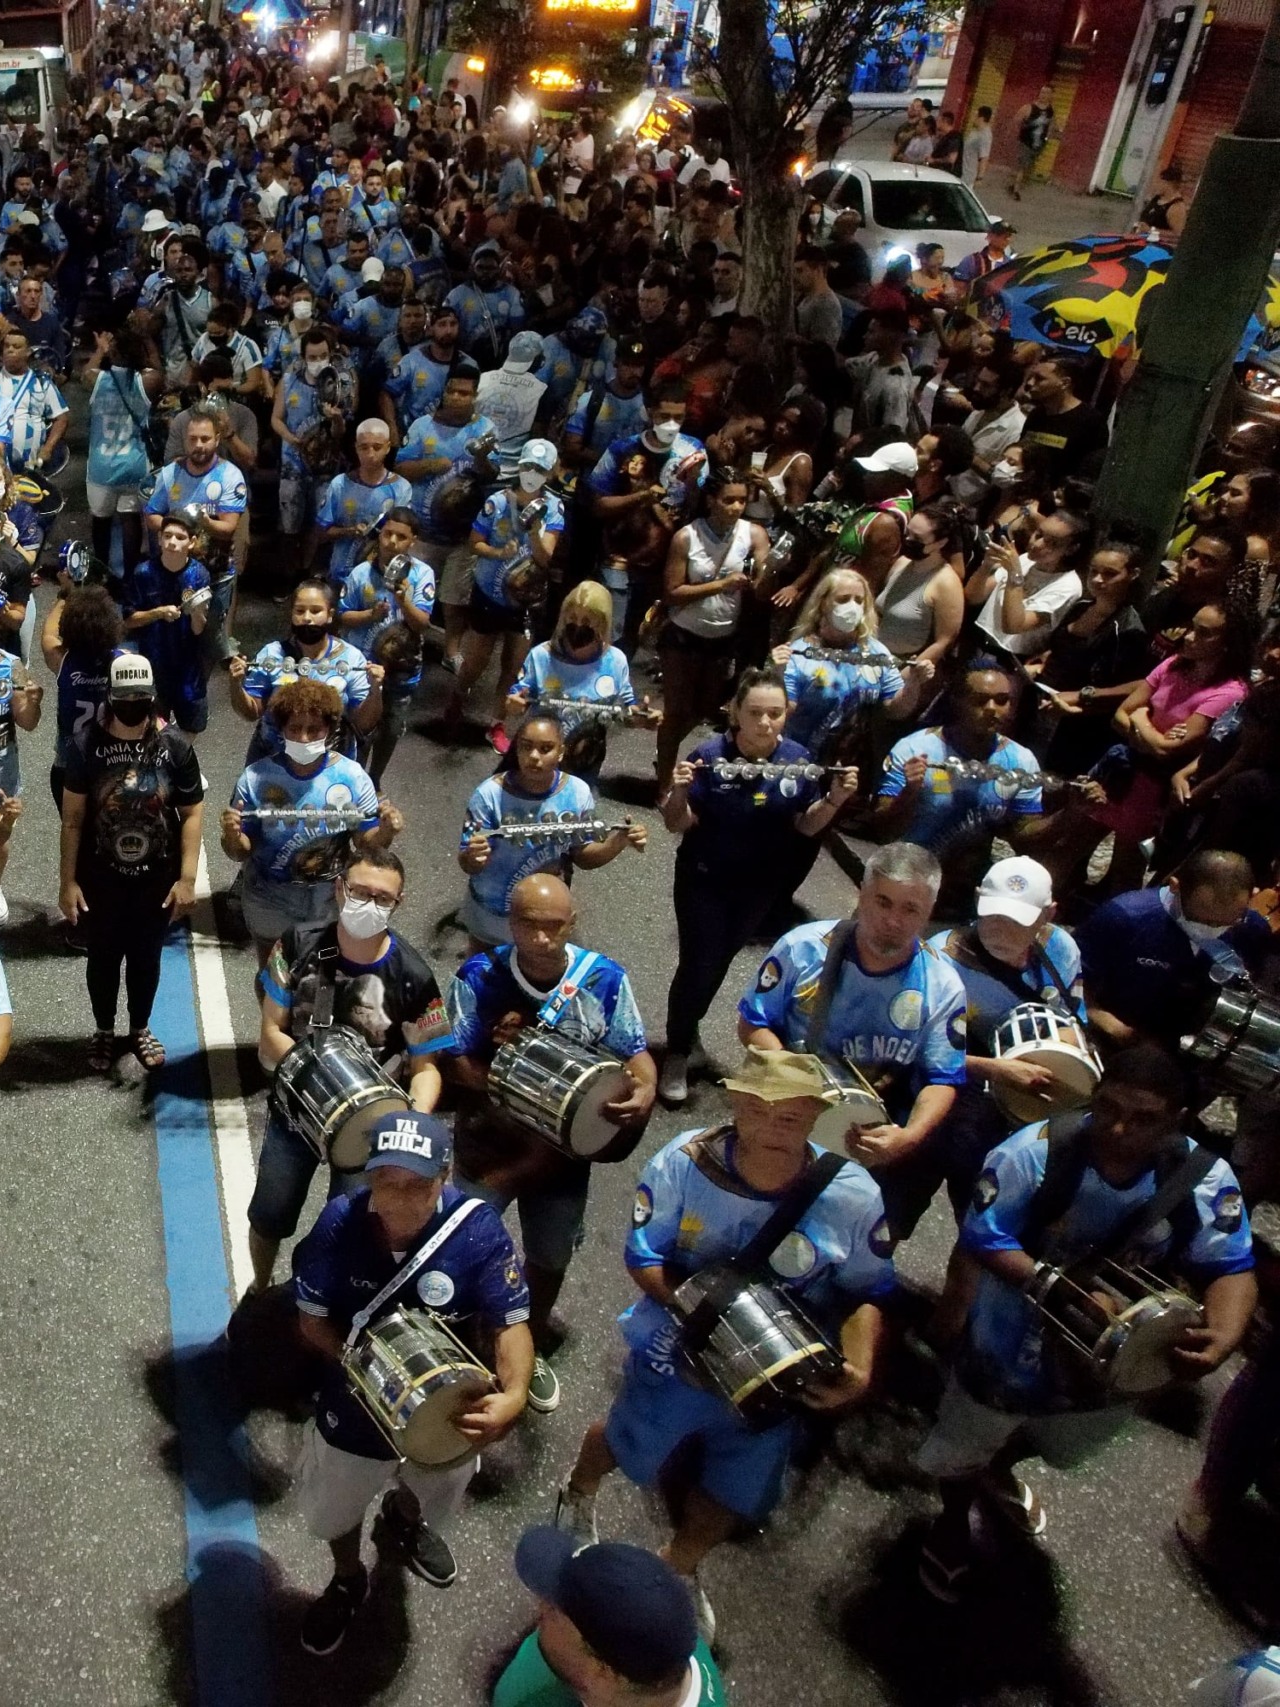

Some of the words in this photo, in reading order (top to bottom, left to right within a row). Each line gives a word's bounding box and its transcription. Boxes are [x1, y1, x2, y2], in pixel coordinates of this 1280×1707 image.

[1065, 325, 1098, 344] elo
[115, 669, 149, 681] CHOCALHO
[841, 1033, 866, 1060] DE
[871, 1033, 919, 1066] NOEL
[396, 1118, 419, 1135] VAI
[377, 1130, 433, 1159] CUICA
